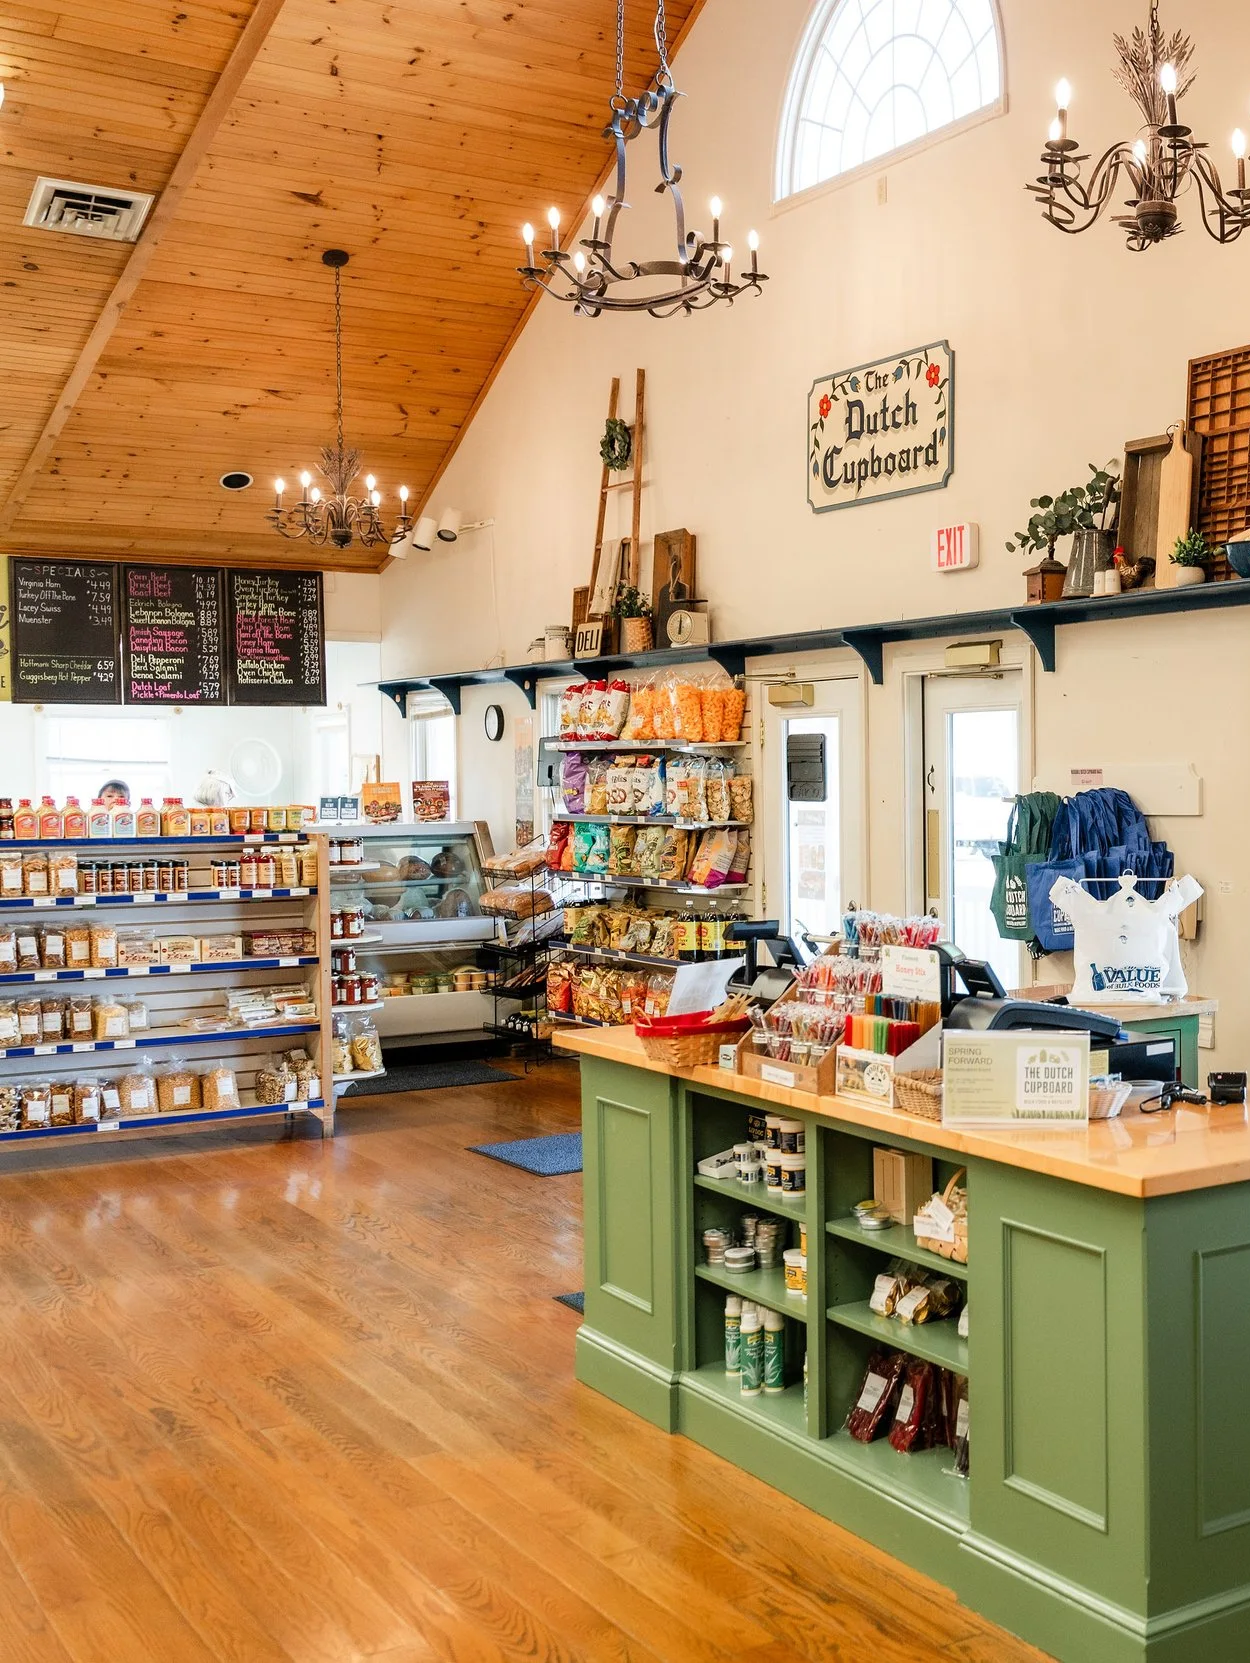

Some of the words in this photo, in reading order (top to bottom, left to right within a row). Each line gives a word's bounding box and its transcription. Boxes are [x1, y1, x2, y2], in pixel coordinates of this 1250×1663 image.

[864, 370, 889, 392] The
[846, 388, 918, 443] Dutch
[823, 428, 939, 493] Cupboard
[937, 526, 965, 567] EXIT
[34, 566, 96, 578] SPECIALS
[128, 571, 147, 581] Corn
[150, 572, 167, 581] Beef
[18, 577, 44, 589] Virginia
[46, 579, 61, 588] Ham
[234, 576, 255, 585] Honey
[256, 576, 280, 587] Turkey
[18, 589, 39, 601] Turkey
[265, 592, 289, 603] Turkey
[18, 602, 39, 614] Lacey
[40, 602, 61, 613] Swiss
[158, 600, 182, 608] Bologna
[130, 607, 163, 616] Lebanon
[165, 608, 194, 619] Bologna
[278, 608, 296, 616] Bone
[172, 617, 196, 627] Bologna
[152, 627, 184, 638] Sausage
[275, 630, 293, 639] Bone
[166, 636, 188, 645] Bacon
[578, 629, 600, 652] DELI
[166, 644, 188, 652] Bacon
[52, 660, 69, 670] Sharp
[131, 654, 146, 663] Deli
[148, 654, 185, 665] Pepperoni
[260, 660, 284, 669] Chicken
[132, 662, 148, 671] Hard
[150, 663, 177, 672] Salami
[258, 668, 284, 677] Chicken
[58, 671, 69, 681] Hot
[70, 672, 92, 684] Pepper
[132, 670, 154, 679] Genoa
[156, 670, 183, 679] Salami
[270, 676, 293, 684] Chicken
[132, 682, 153, 691] Dutch
[154, 682, 172, 691] Loaf
[132, 689, 154, 699] Pickle
[184, 690, 200, 699] Loaf
[1104, 969, 1161, 983] VALUE
[949, 1048, 982, 1056] SPRING
[948, 1057, 993, 1065] FORWARD
[1024, 1067, 1041, 1079] THE
[1044, 1067, 1073, 1079] DUTCH
[1024, 1081, 1073, 1093] CUPBOARD
